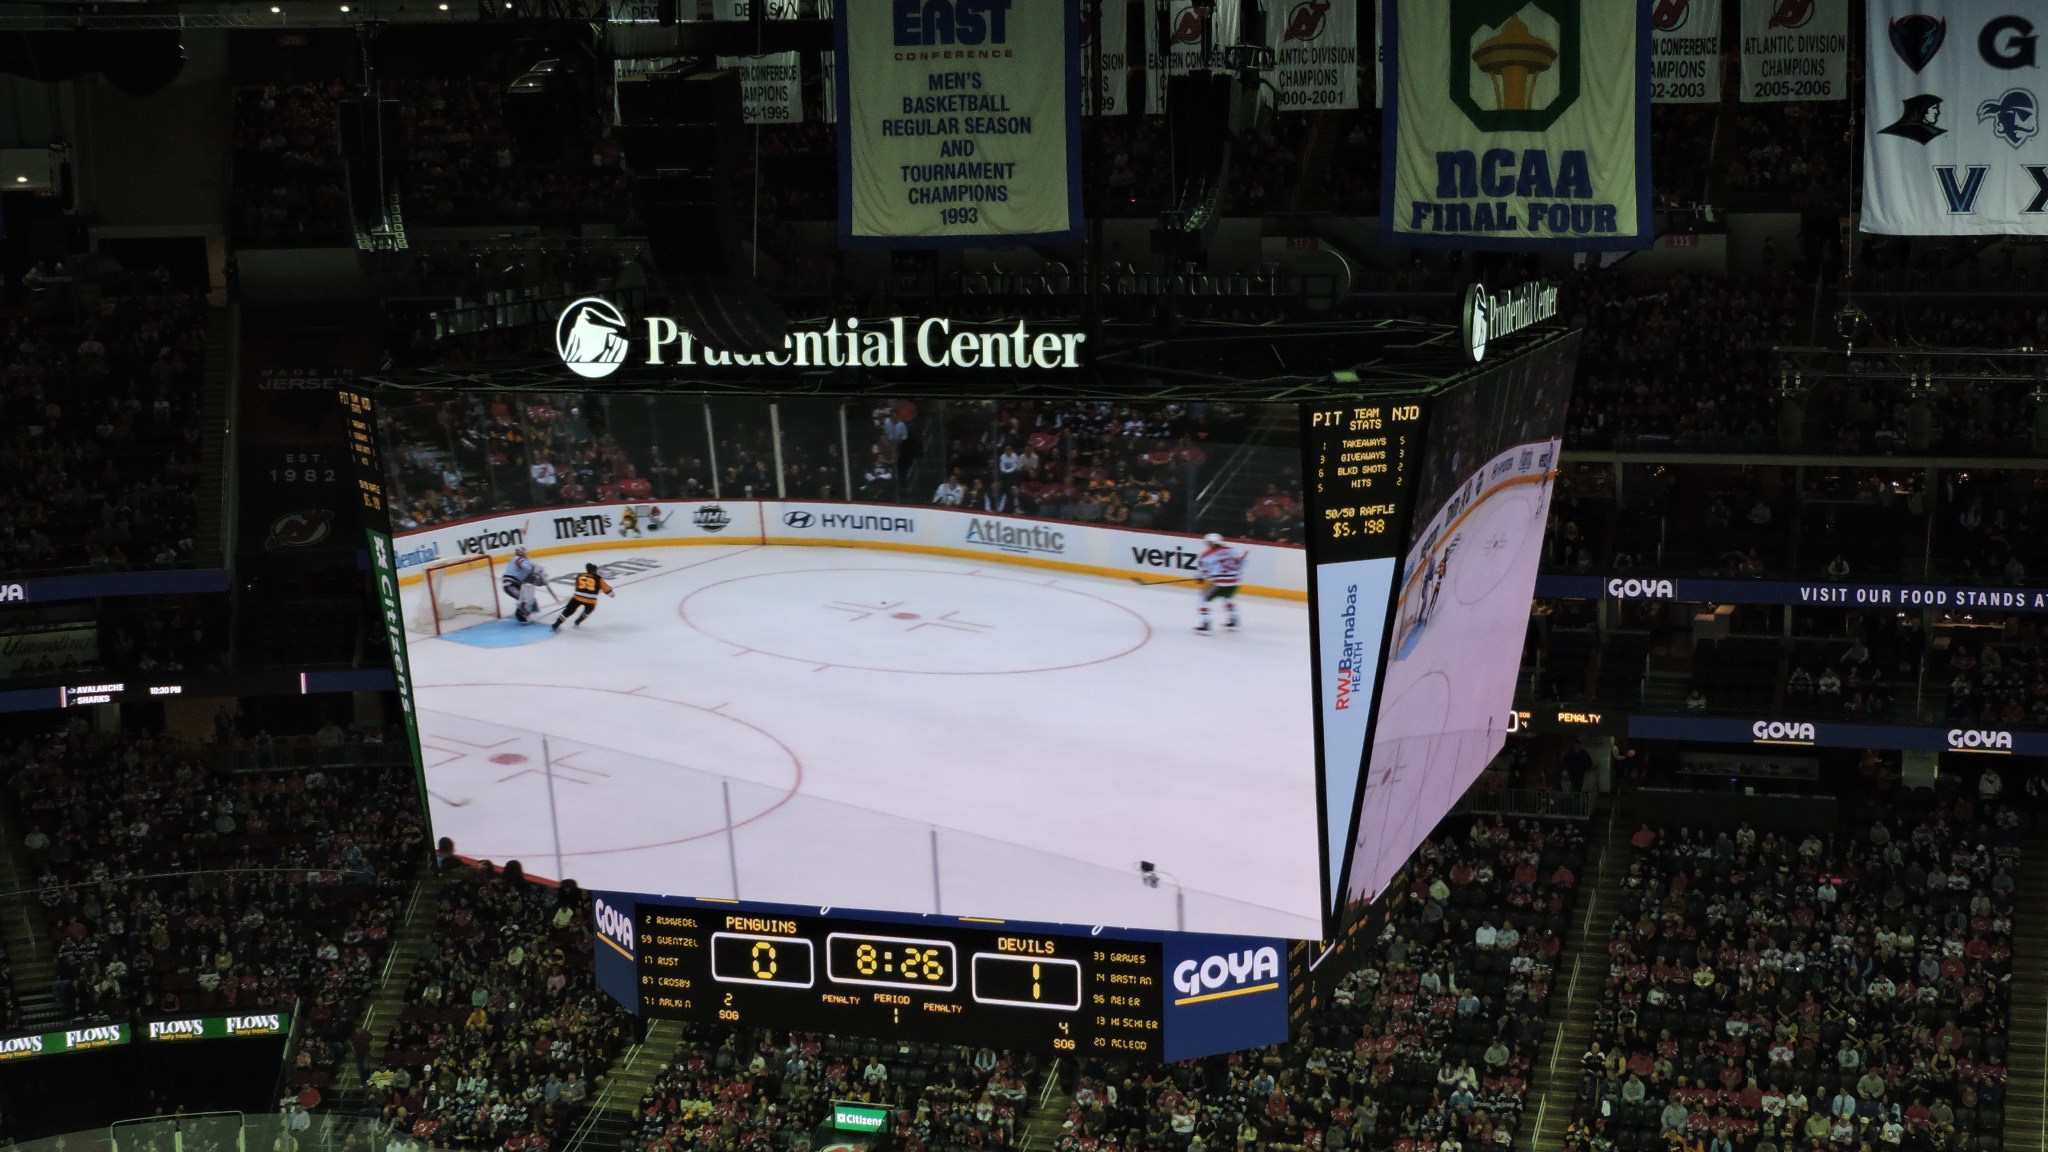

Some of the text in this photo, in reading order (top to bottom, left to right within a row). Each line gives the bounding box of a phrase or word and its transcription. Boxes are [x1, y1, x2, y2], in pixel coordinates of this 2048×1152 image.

[893, 0, 1012, 46] EAST
[1661, 37, 1717, 56] CONFERENCE
[1744, 35, 1845, 54] ATLANTIC DIVISION
[1977, 14, 2040, 70] G
[894, 50, 1013, 61] CONFERENCE
[1280, 47, 1354, 64] ANTIC DIVISION
[752, 65, 796, 81] CONFERENCE
[1650, 60, 1706, 79] AMPIONS
[1762, 58, 1825, 78] CHAMPIONS
[929, 72, 982, 90] MEN'S
[1279, 69, 1338, 87] CHAMPIONS
[742, 85, 788, 101] AMPIONS
[1650, 82, 1705, 98] 02-2003
[1754, 81, 1831, 97] 2005-2006
[903, 95, 1010, 113] BASKETBALL
[744, 106, 789, 120] 94-1995
[882, 117, 1032, 136] REGULAR SEASON
[940, 140, 974, 157] AND
[901, 163, 1015, 182] TOURNAMENT
[908, 185, 1008, 204] CHAMPIONS
[940, 208, 978, 225] 1993
[1527, 203, 1617, 233] FOUR
[1489, 281, 1557, 340] Prudential Center
[917, 315, 1087, 370] Center
[258, 378, 338, 390] JERSE
[1312, 406, 1420, 427] PIT TEAM NJD
[1349, 419, 1382, 431] STATS
[1342, 438, 1387, 448] TAKEAWAYS
[286, 454, 327, 463] EST.
[1341, 451, 1386, 462] GIVEAWAYS
[270, 470, 336, 482] 1982
[1318, 469, 1324, 478] 6
[1337, 466, 1358, 476] BLKD
[1362, 464, 1387, 474] SHOTS
[1351, 479, 1372, 488] HITS
[1325, 504, 1395, 519] 50/50 RAFFLE
[822, 513, 914, 533] HYUNDAI
[457, 528, 523, 556] verizon
[966, 517, 1065, 552] Atlantic
[1132, 545, 1198, 571] veriz
[0, 584, 24, 601] YA
[1608, 579, 1673, 599] GOYA
[1800, 588, 1847, 602] VISIT
[1857, 589, 1891, 603] OUR
[1901, 590, 1947, 604] FOOD
[1956, 591, 2025, 607] STANDS
[381, 574, 411, 713] Citizens
[1351, 641, 1363, 692] HEALTH
[77, 684, 125, 694] AVALANCHE
[169, 686, 181, 694] PM
[77, 695, 110, 705] SHARKS
[1558, 713, 1601, 723] PENALTY
[1753, 720, 1815, 740] GOYA
[1948, 729, 2012, 750] GOYA
[595, 898, 634, 951] GOYA
[645, 915, 652, 924] 2
[726, 916, 797, 934] PENGUINS
[641, 935, 652, 944] 59
[998, 937, 1055, 954] DEVILS
[644, 956, 679, 966] 17 RUST
[752, 941, 777, 980] 0
[856, 944, 944, 981] 8:26
[1093, 951, 1146, 964] 33 GRAVES
[1096, 973, 1152, 986] 14 BASTIAN
[1173, 946, 1279, 996] GOYA
[642, 976, 690, 988] 87 CROSBY
[1032, 962, 1041, 1001] 1
[644, 996, 655, 1006] 71
[724, 993, 733, 1006] 2
[822, 993, 963, 1014] PENALTY PERIOD PENALTY
[1093, 994, 1105, 1004] 96
[226, 1014, 280, 1033] FLOWS
[719, 1009, 739, 1021] SOG
[1096, 1016, 1106, 1026] 13
[66, 1025, 120, 1047] FLOWS
[149, 1020, 203, 1038] FLOWS
[1058, 1022, 1069, 1035] 4
[0, 1035, 43, 1053] LOWS
[1053, 1038, 1076, 1050] SOG
[1093, 1037, 1106, 1047] 20
[846, 1114, 882, 1126] Citizens
